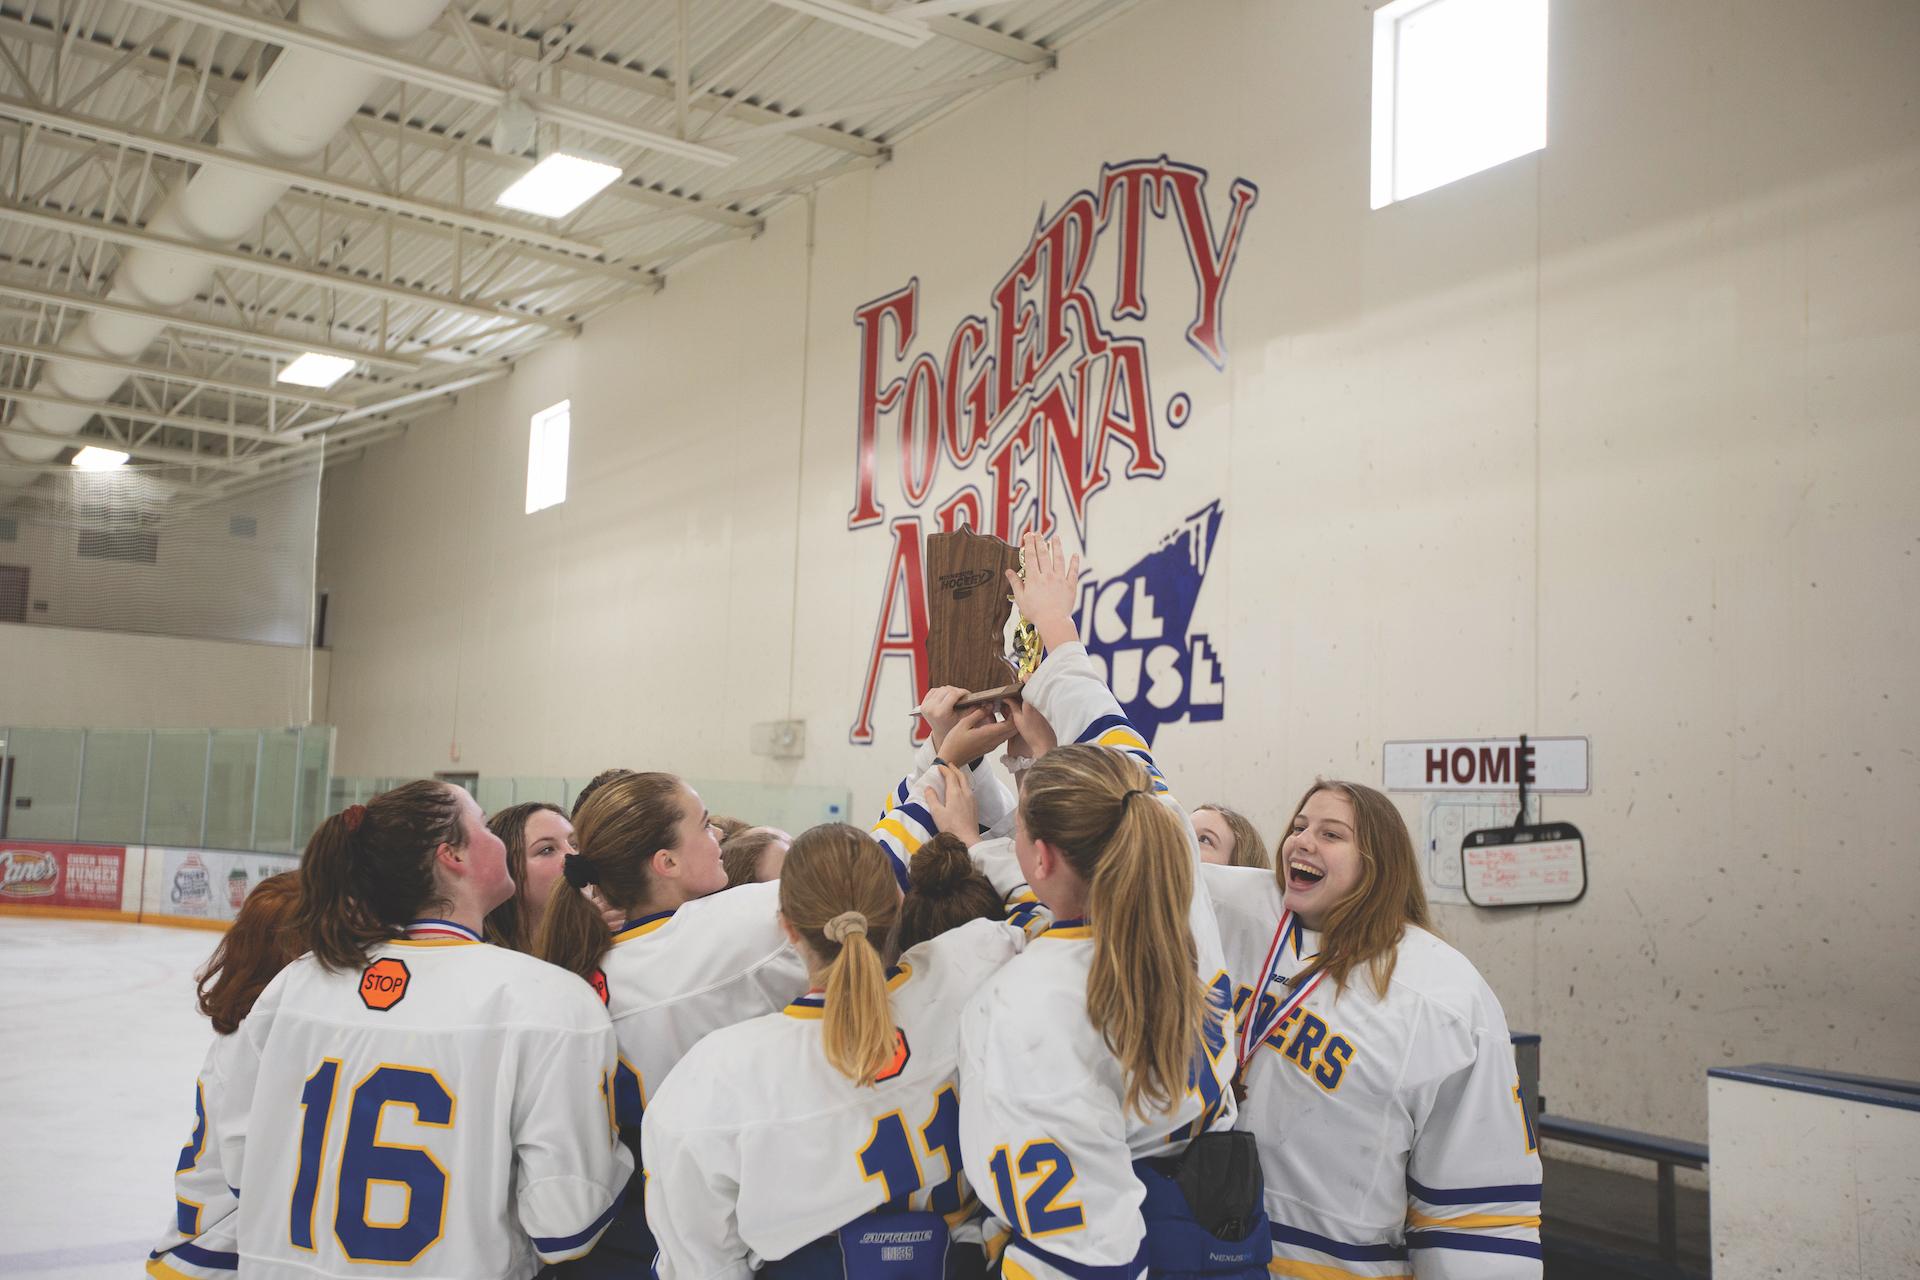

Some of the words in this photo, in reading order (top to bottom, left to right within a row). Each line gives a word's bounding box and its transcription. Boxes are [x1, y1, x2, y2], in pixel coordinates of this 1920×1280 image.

[848, 153, 1259, 530] FOGERTY
[941, 573, 986, 590] HOCKEY
[1088, 640, 1223, 709] USE
[1425, 746, 1536, 784] HOME
[365, 973, 403, 993] STOP
[290, 1057, 457, 1267] 16
[988, 1138, 1087, 1238] 12
